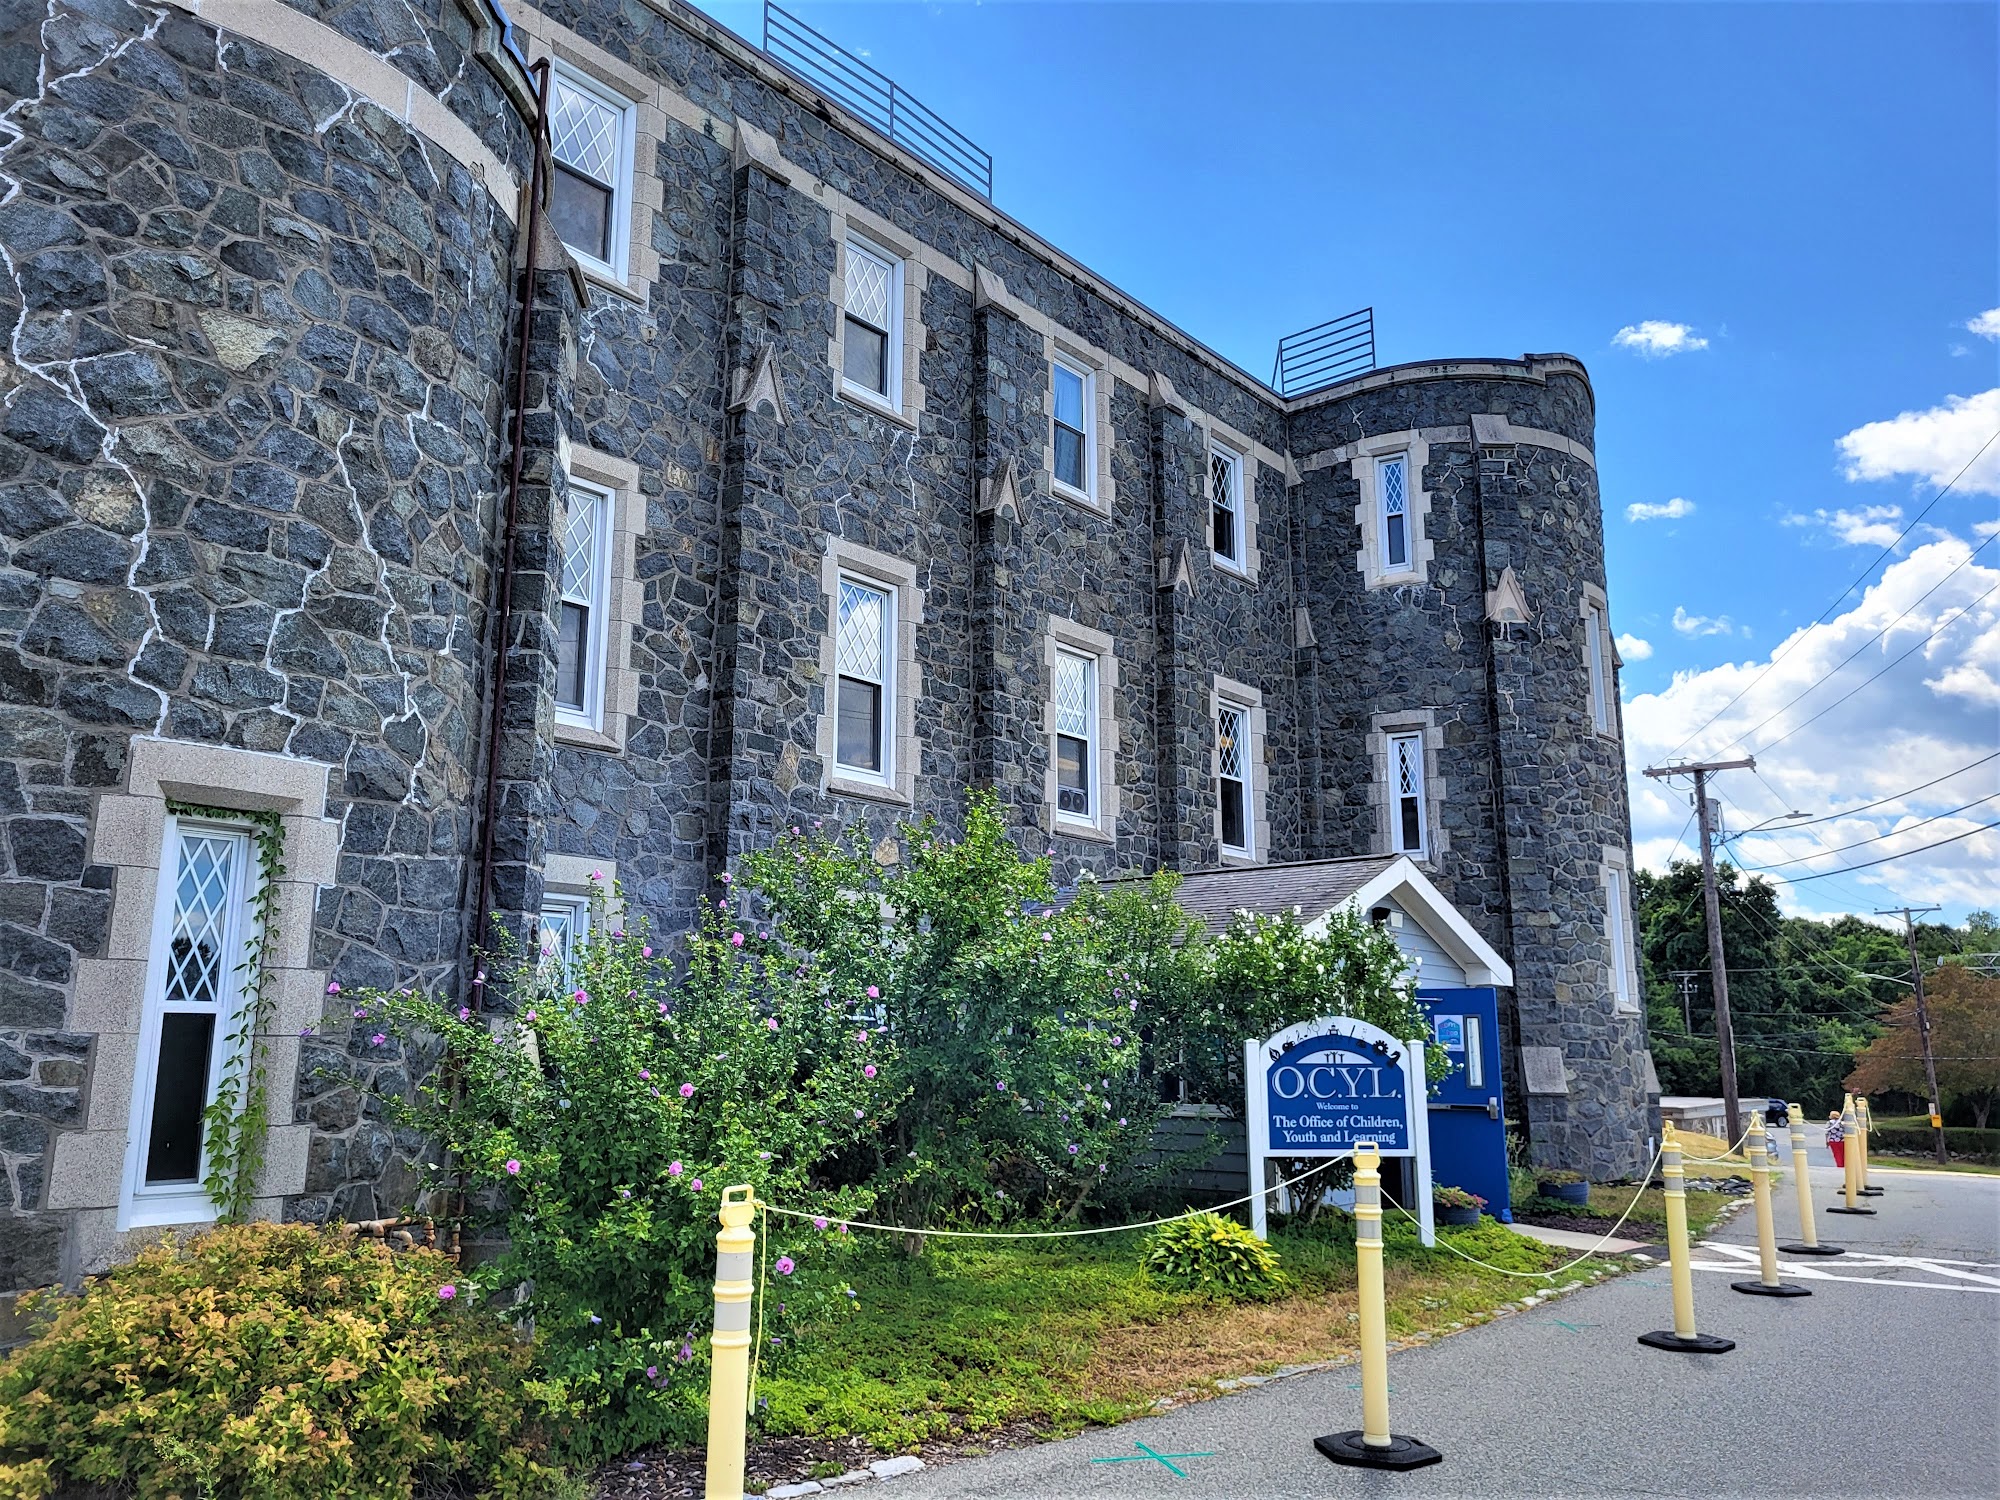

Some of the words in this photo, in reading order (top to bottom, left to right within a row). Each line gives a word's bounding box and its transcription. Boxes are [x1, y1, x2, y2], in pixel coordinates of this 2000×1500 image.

[1271, 1066, 1402, 1099] O.C.Y.L.
[1316, 1102, 1349, 1110] Welcome
[1351, 1102, 1359, 1110] to
[1273, 1115, 1297, 1128] The
[1299, 1115, 1334, 1128] Office
[1336, 1115, 1349, 1128] of
[1350, 1115, 1404, 1129] Children,
[1282, 1130, 1319, 1143] Youth
[1320, 1130, 1341, 1143] and
[1344, 1130, 1396, 1145] Learning
